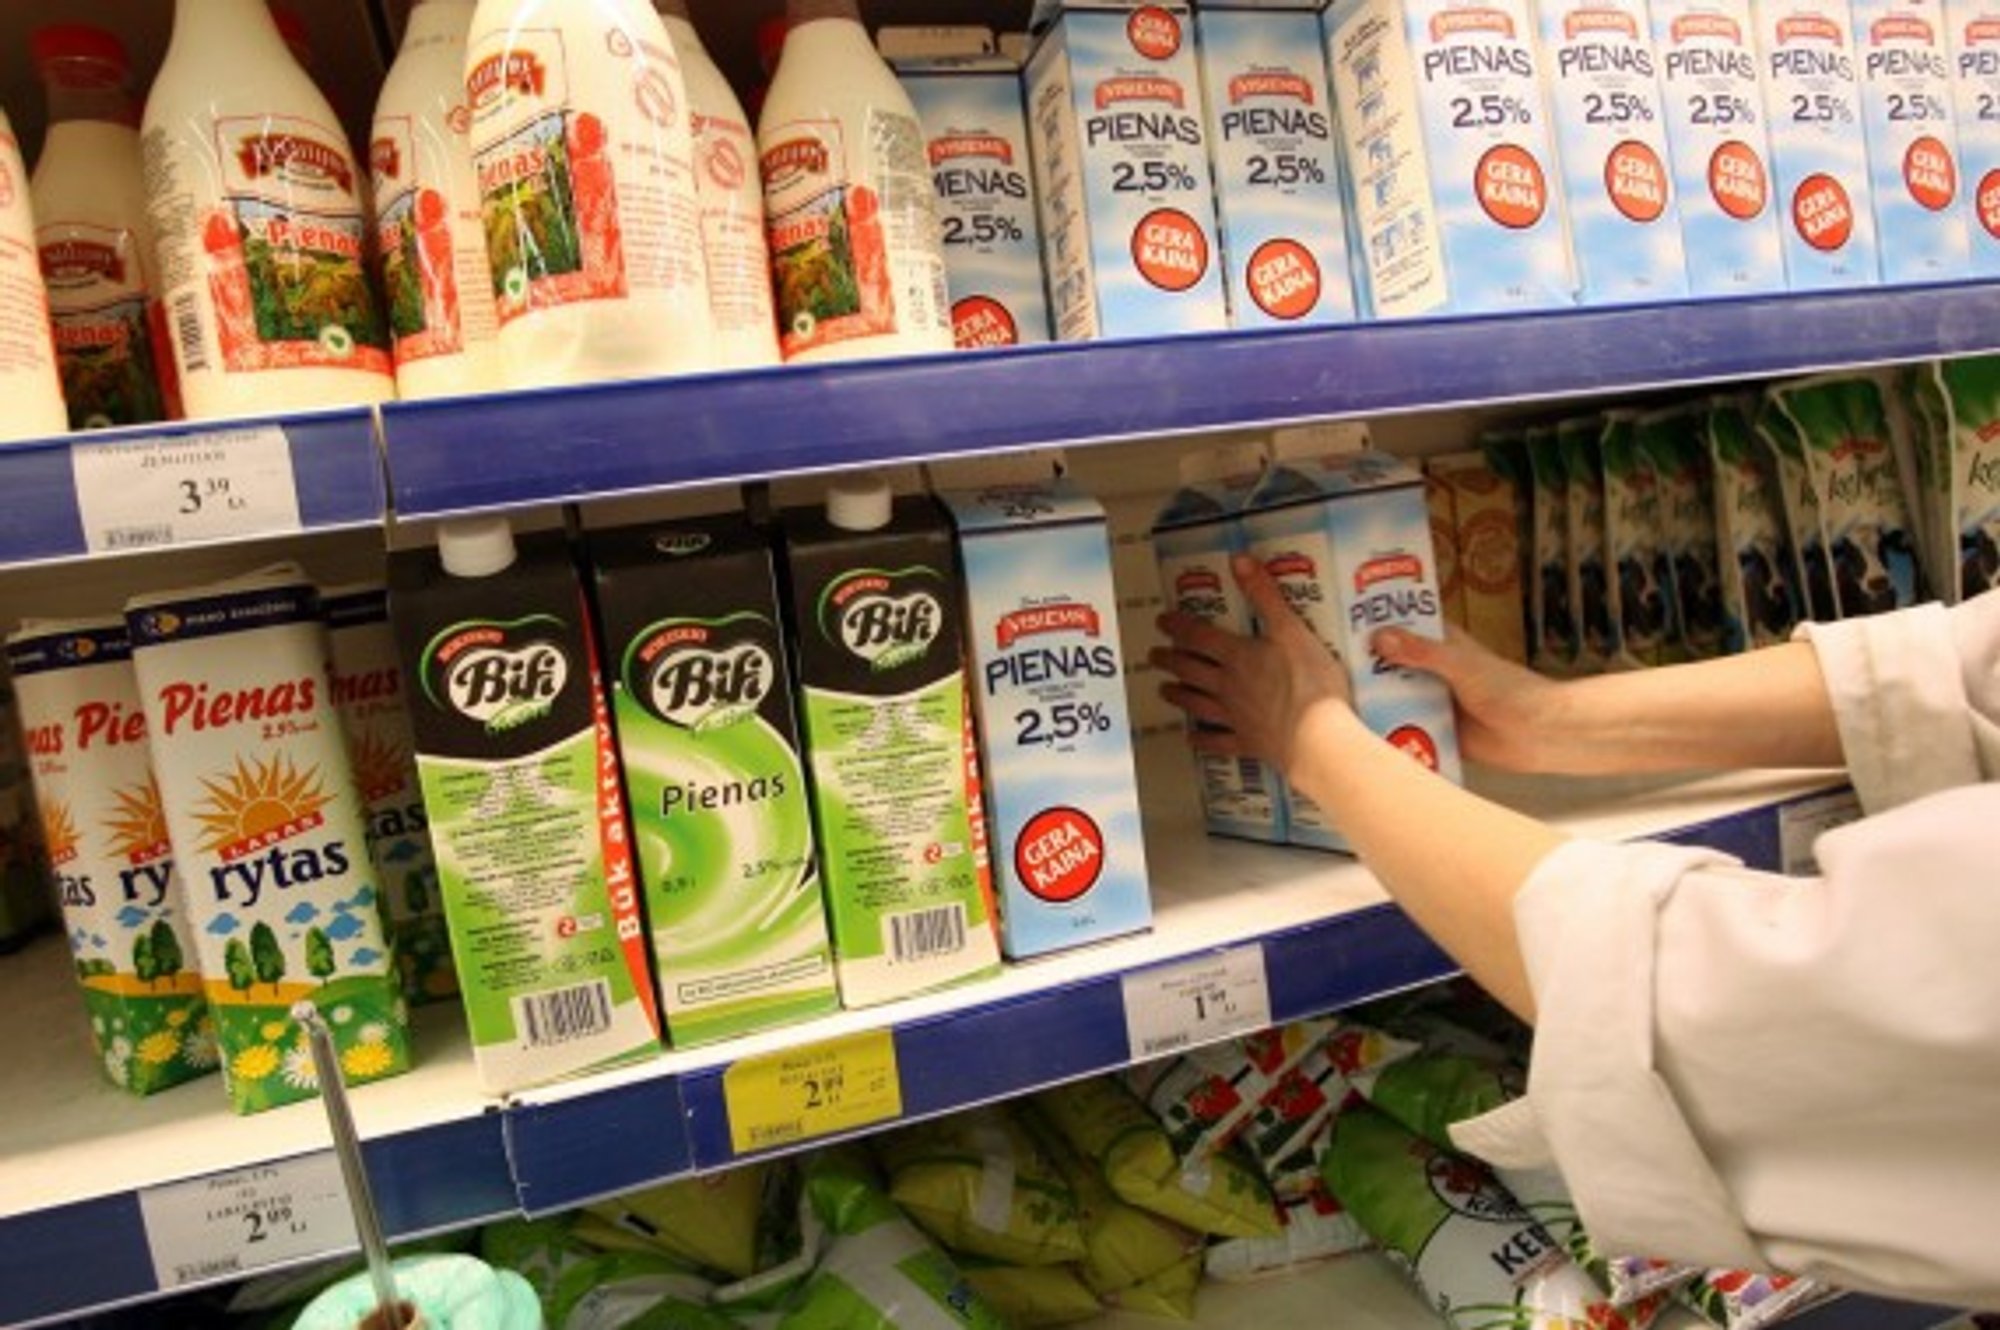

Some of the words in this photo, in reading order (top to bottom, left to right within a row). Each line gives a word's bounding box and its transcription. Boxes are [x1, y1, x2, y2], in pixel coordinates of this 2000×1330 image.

[1424, 46, 1532, 82] PIENAS
[1558, 45, 1654, 79] PIENAS
[1666, 50, 1756, 82] PIENAS
[1770, 49, 1853, 81] PIENAS
[1866, 49, 1947, 78] PIENAS
[1958, 50, 2000, 79] PIE
[1087, 112, 1201, 146] PIENAS
[1222, 108, 1329, 141] PIENAS
[1112, 162, 1197, 196] 2,5%
[1246, 155, 1326, 188] 2,5%
[1486, 161, 1534, 185] GERA
[942, 214, 1023, 245] 2,5%
[1145, 223, 1195, 250] GERA
[1142, 245, 1200, 274] KAINA
[1255, 251, 1300, 286] GERA
[1262, 268, 1315, 306] KAINA
[179, 480, 202, 514] 3
[206, 477, 230, 497] 39
[845, 598, 934, 647] Bifi
[1349, 589, 1437, 633] PIENAS
[455, 648, 557, 709] Bifi
[657, 649, 763, 713] Bifi
[985, 644, 1117, 695] PIENAS
[157, 676, 317, 735] Pienas
[1013, 702, 1112, 748] 2,5%
[661, 773, 786, 817] Pienas
[1024, 820, 1083, 866] GERA
[209, 839, 350, 908] rytas
[1030, 837, 1101, 890] KAINA
[1195, 995, 1205, 1020] 1
[804, 1079, 823, 1109] 2
[243, 1212, 267, 1243] 2
